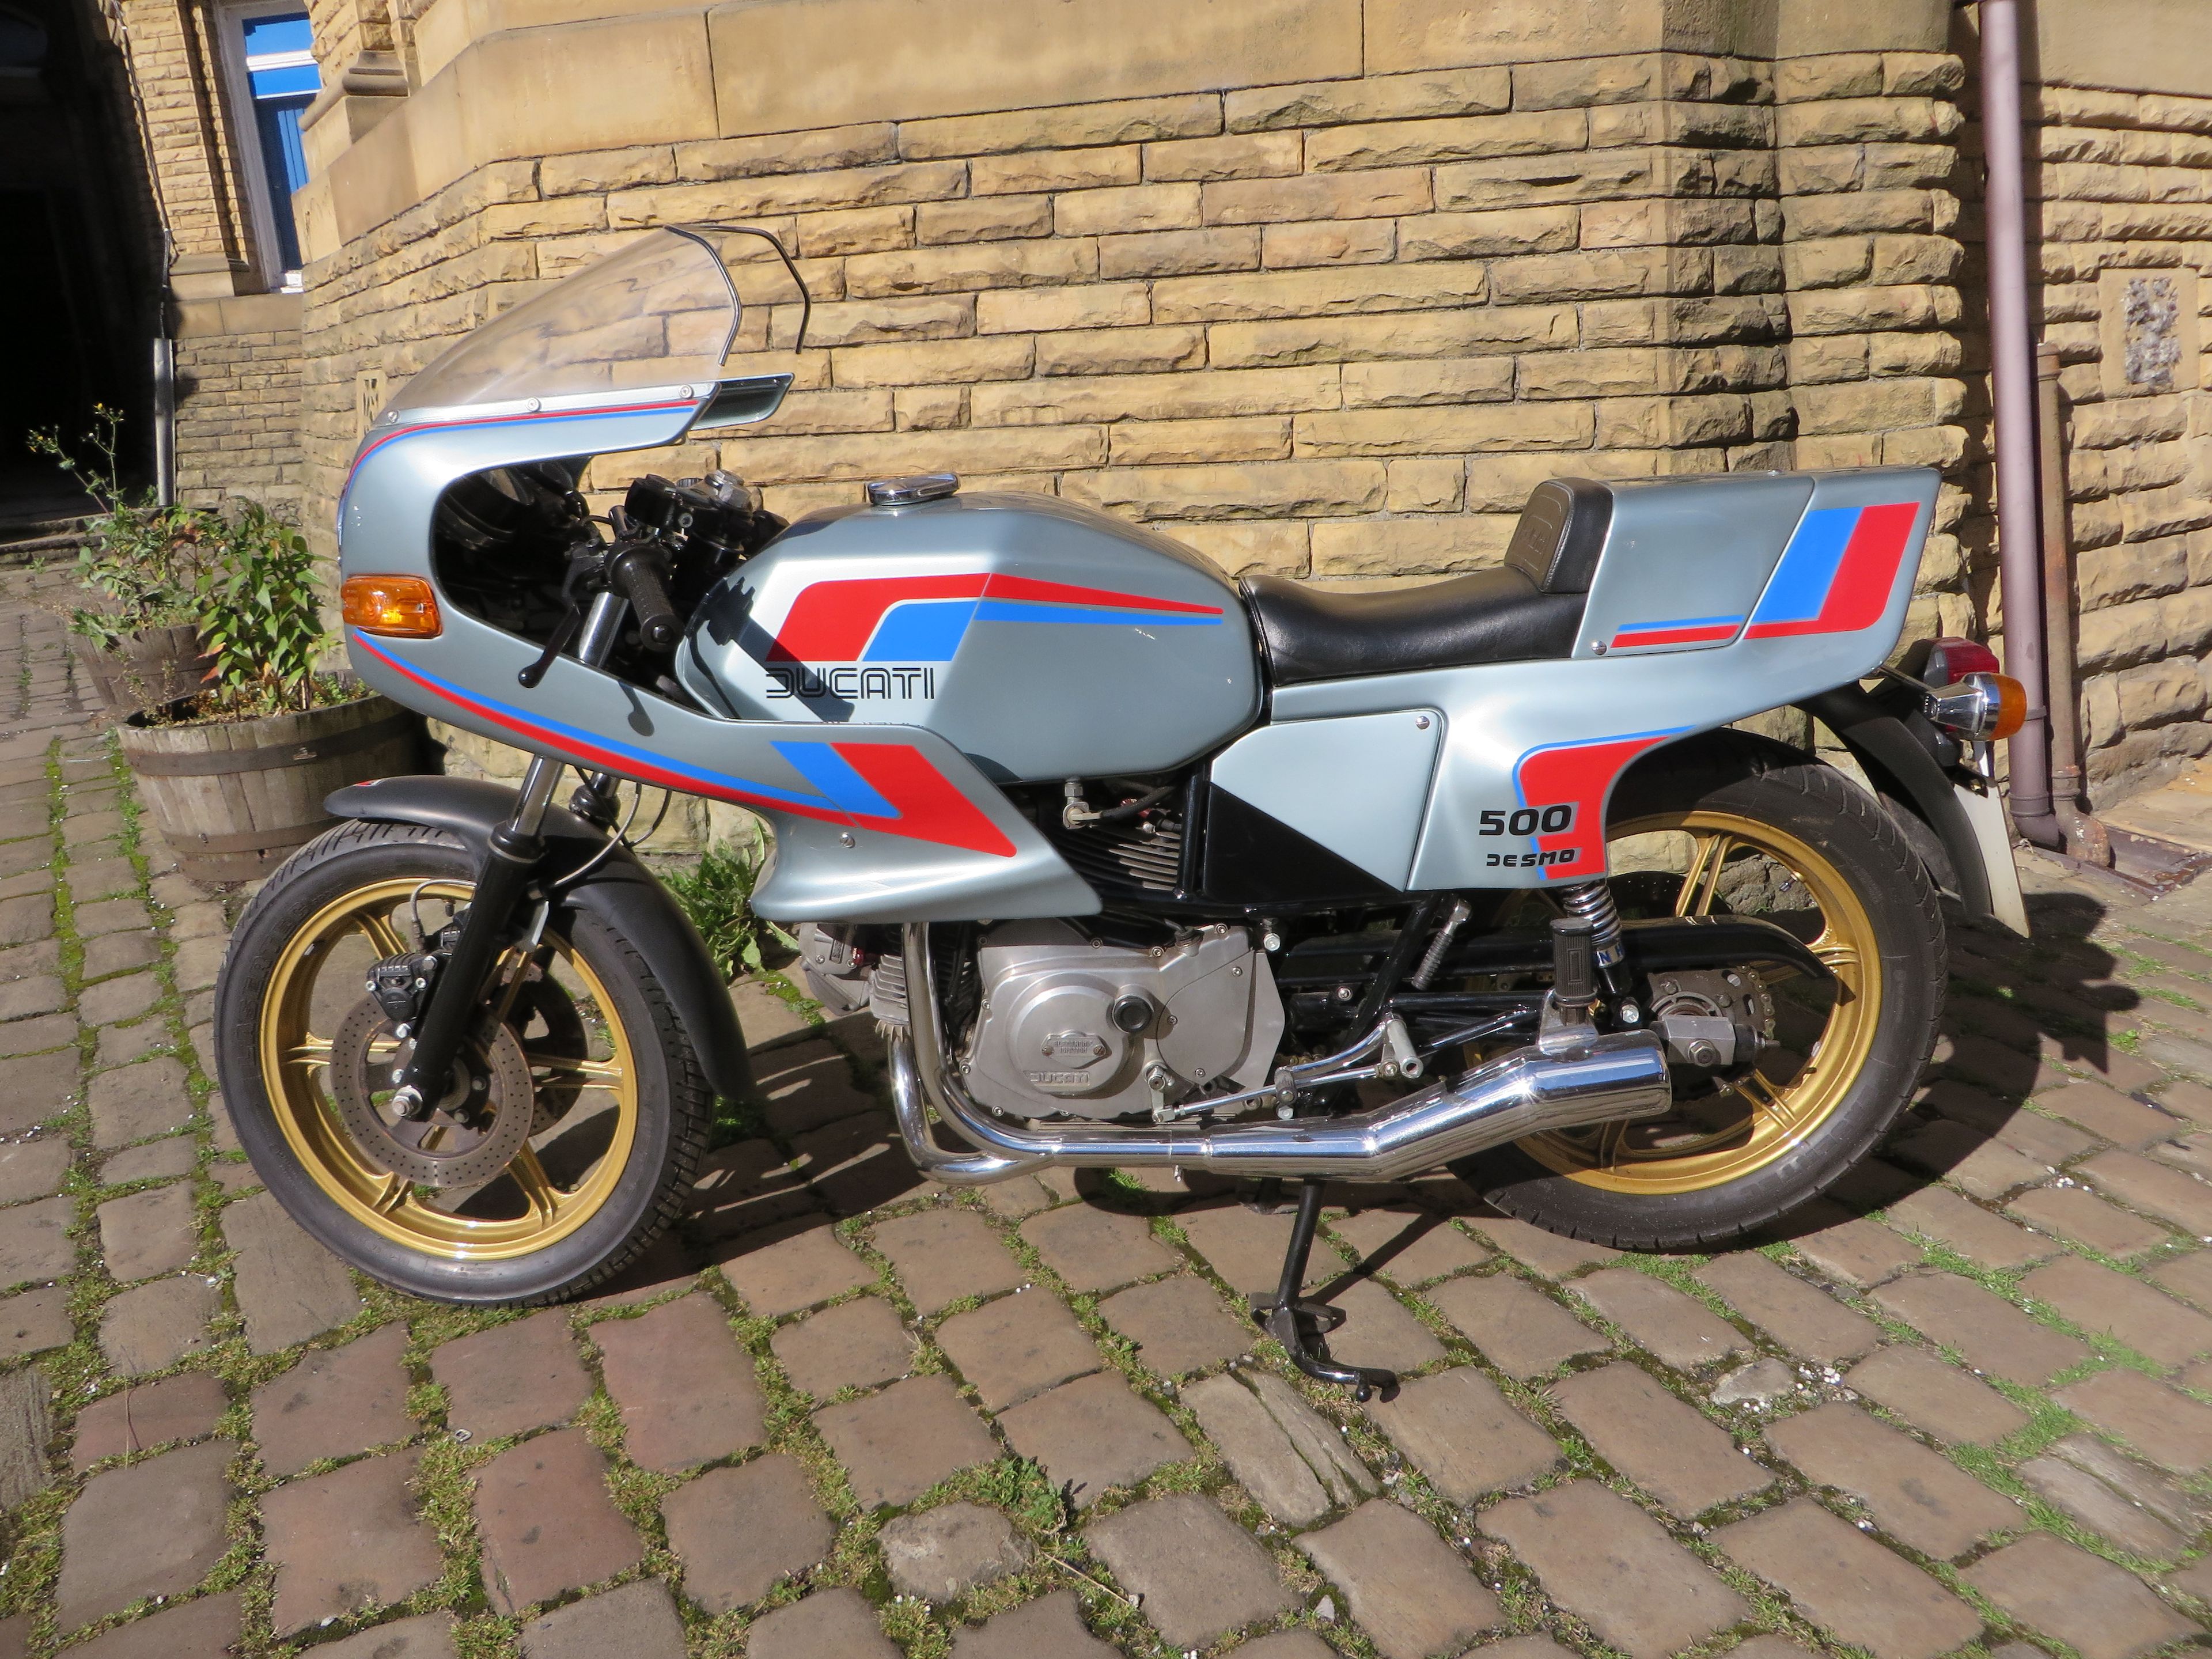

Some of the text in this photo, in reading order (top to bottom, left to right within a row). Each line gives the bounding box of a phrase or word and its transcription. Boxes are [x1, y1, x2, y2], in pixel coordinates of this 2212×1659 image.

[766, 668, 934, 699] DUCATI
[1479, 805, 1571, 835] 500
[1486, 849, 1575, 867] DESMO
[1030, 1074, 1089, 1083] DUCATI
